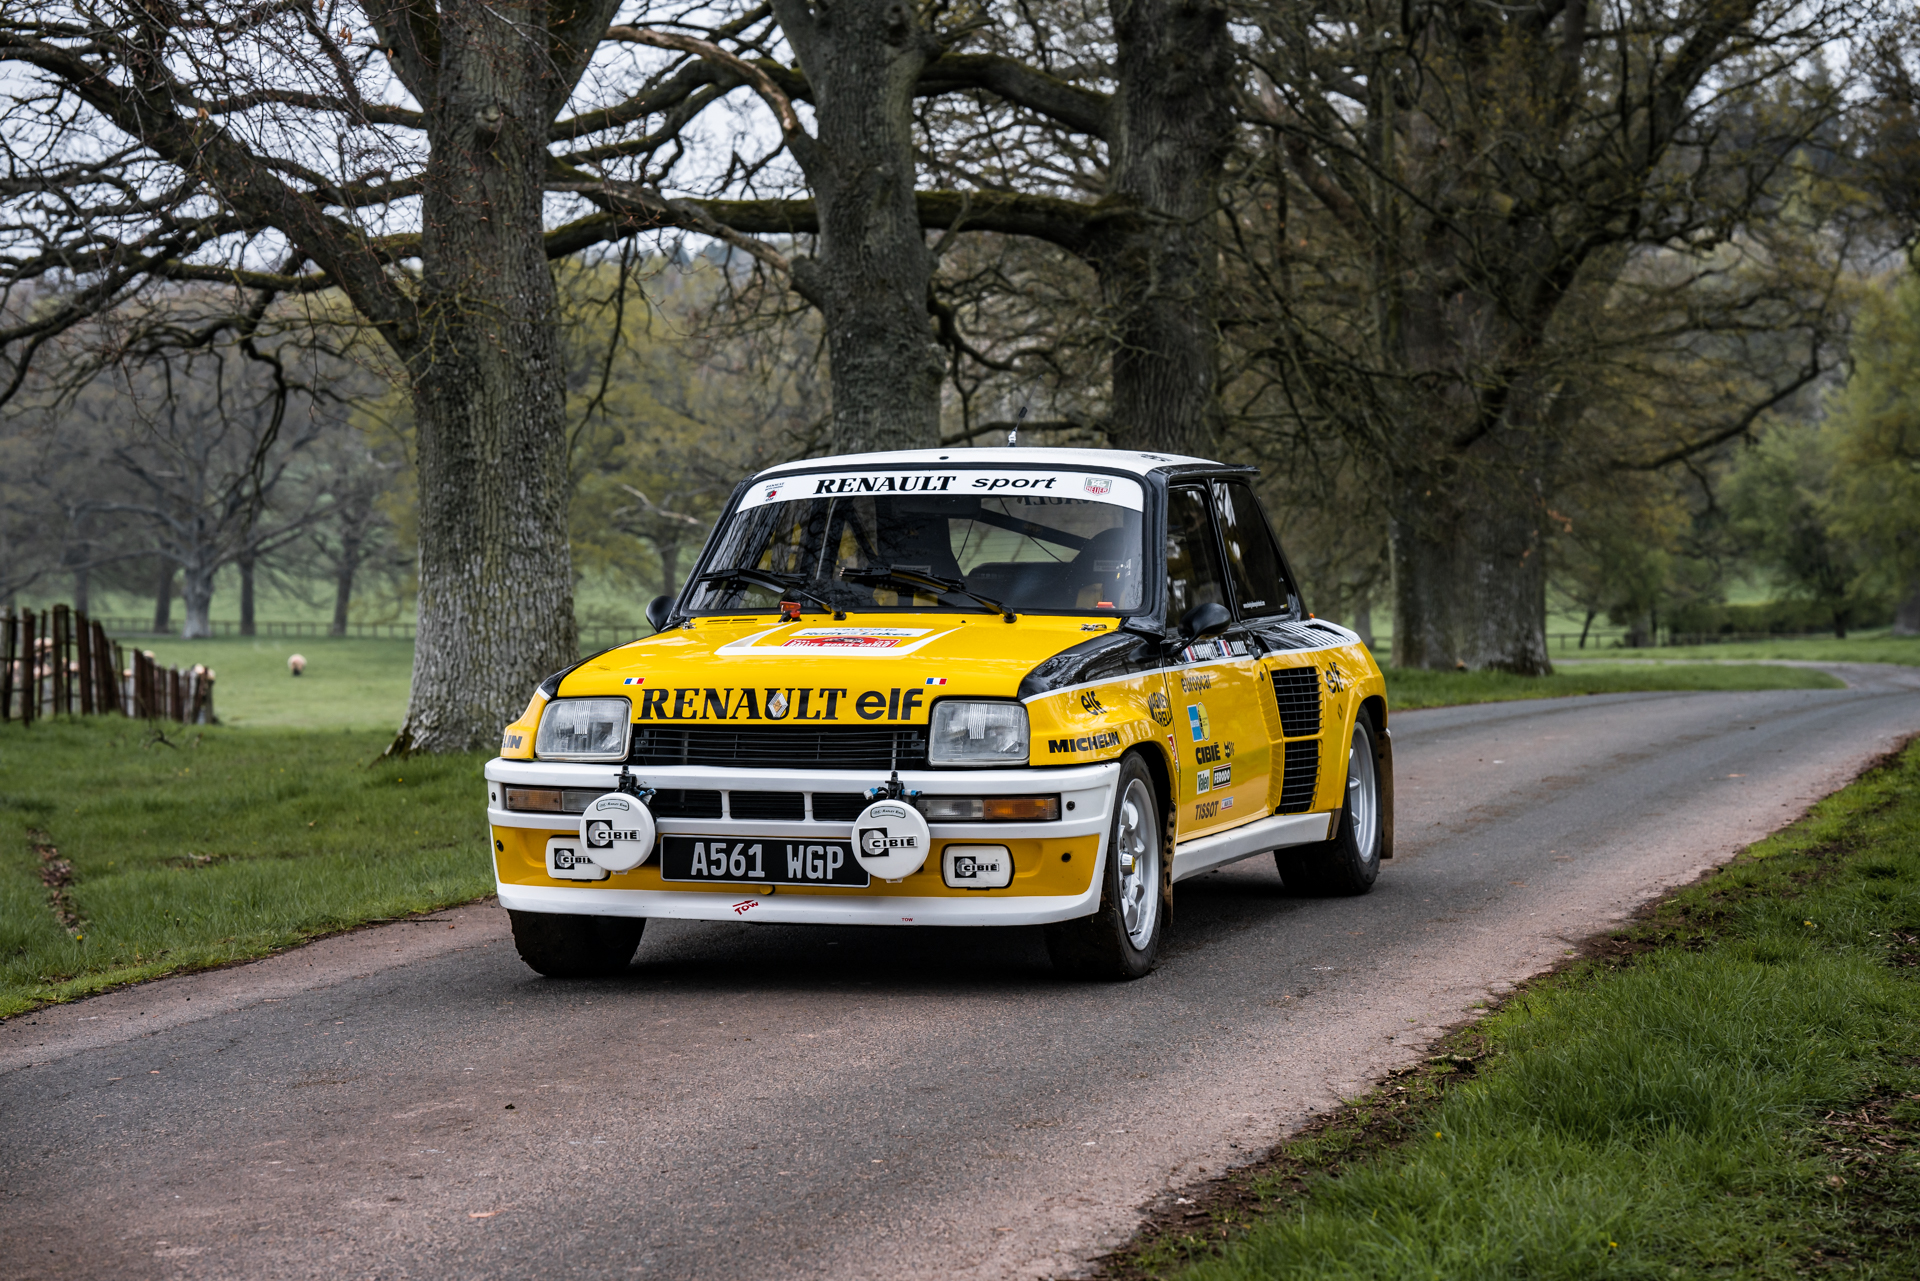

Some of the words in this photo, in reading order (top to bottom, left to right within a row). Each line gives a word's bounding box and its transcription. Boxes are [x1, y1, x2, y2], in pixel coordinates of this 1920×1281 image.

[813, 475, 957, 495] RENAULT
[971, 476, 1057, 493] sport
[1325, 661, 1344, 694] elf
[638, 687, 847, 721] RENAULT
[855, 687, 923, 721] elf
[1080, 690, 1108, 716] elf
[1048, 731, 1121, 754] MICHELIN
[1197, 772, 1209, 792] Valeo
[1213, 768, 1231, 785] FERODO
[1195, 800, 1220, 821] TISSOT
[690, 841, 766, 878] A561
[786, 844, 845, 880] WGP
[734, 901, 759, 916] TOW
